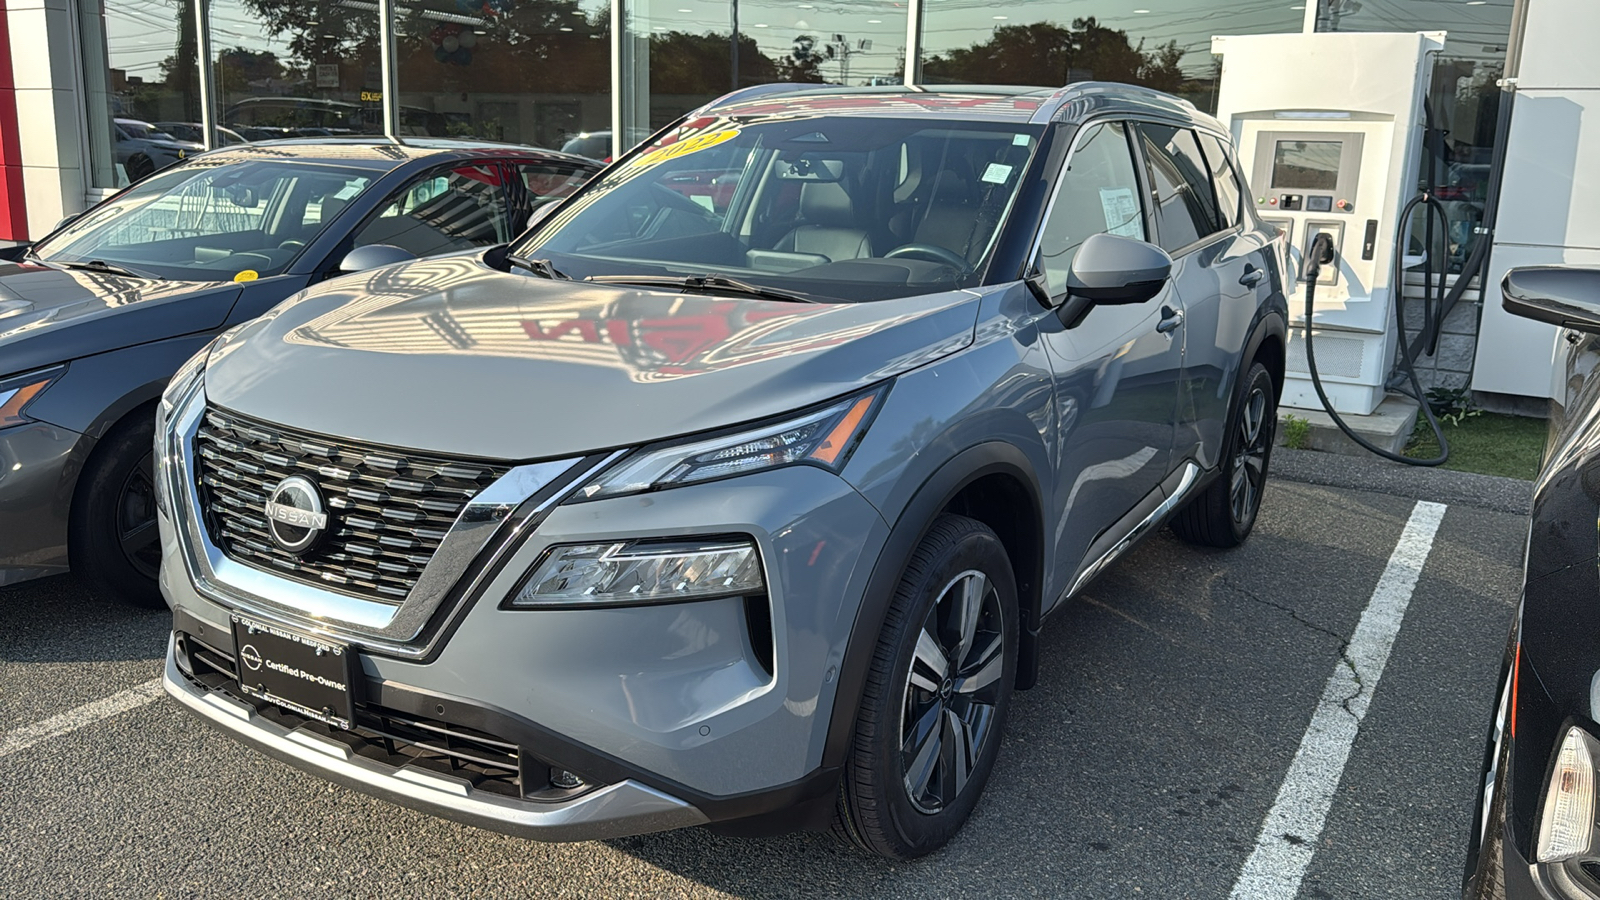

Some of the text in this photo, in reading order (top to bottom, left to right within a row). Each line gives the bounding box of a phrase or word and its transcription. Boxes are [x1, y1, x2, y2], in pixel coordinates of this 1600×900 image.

[648, 132, 722, 162] 2022
[266, 503, 324, 528] NISSAN
[241, 618, 269, 633] COLONIAL
[269, 628, 291, 640] NISSAN
[301, 637, 330, 652] MEDFORD
[240, 651, 263, 664] NISSAN
[265, 659, 299, 677] Certified
